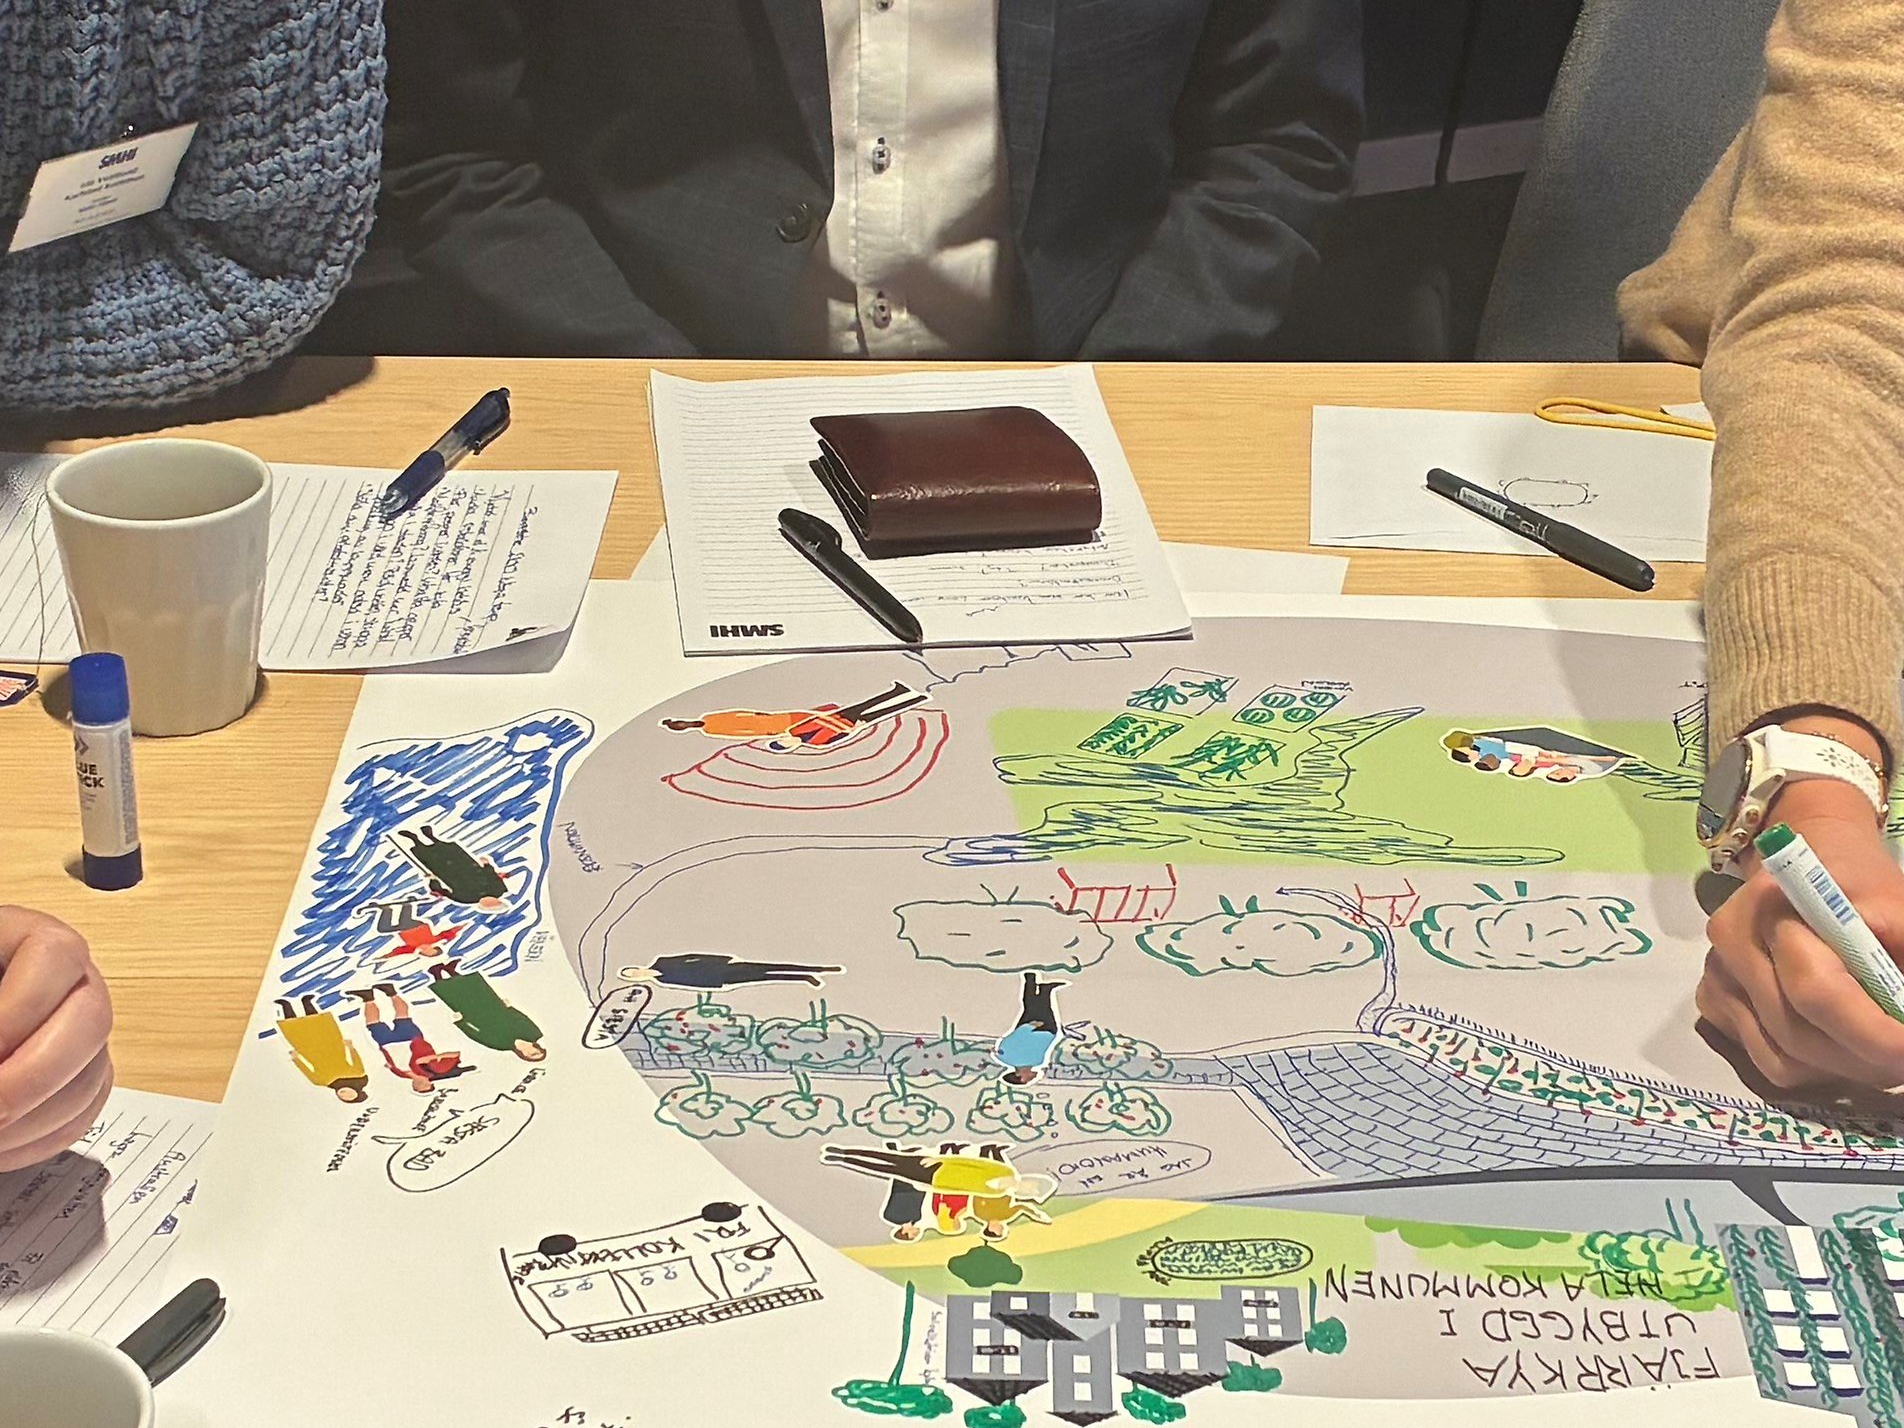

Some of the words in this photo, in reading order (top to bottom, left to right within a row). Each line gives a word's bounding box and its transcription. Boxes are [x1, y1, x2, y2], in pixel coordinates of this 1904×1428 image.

[99, 147, 138, 169] SMHI
[709, 622, 784, 639] SMHI
[1325, 1264, 1545, 1303] KOMMUNEN
[1560, 1269, 1663, 1301] HELA
[1483, 1307, 1698, 1345] UTBYGGD
